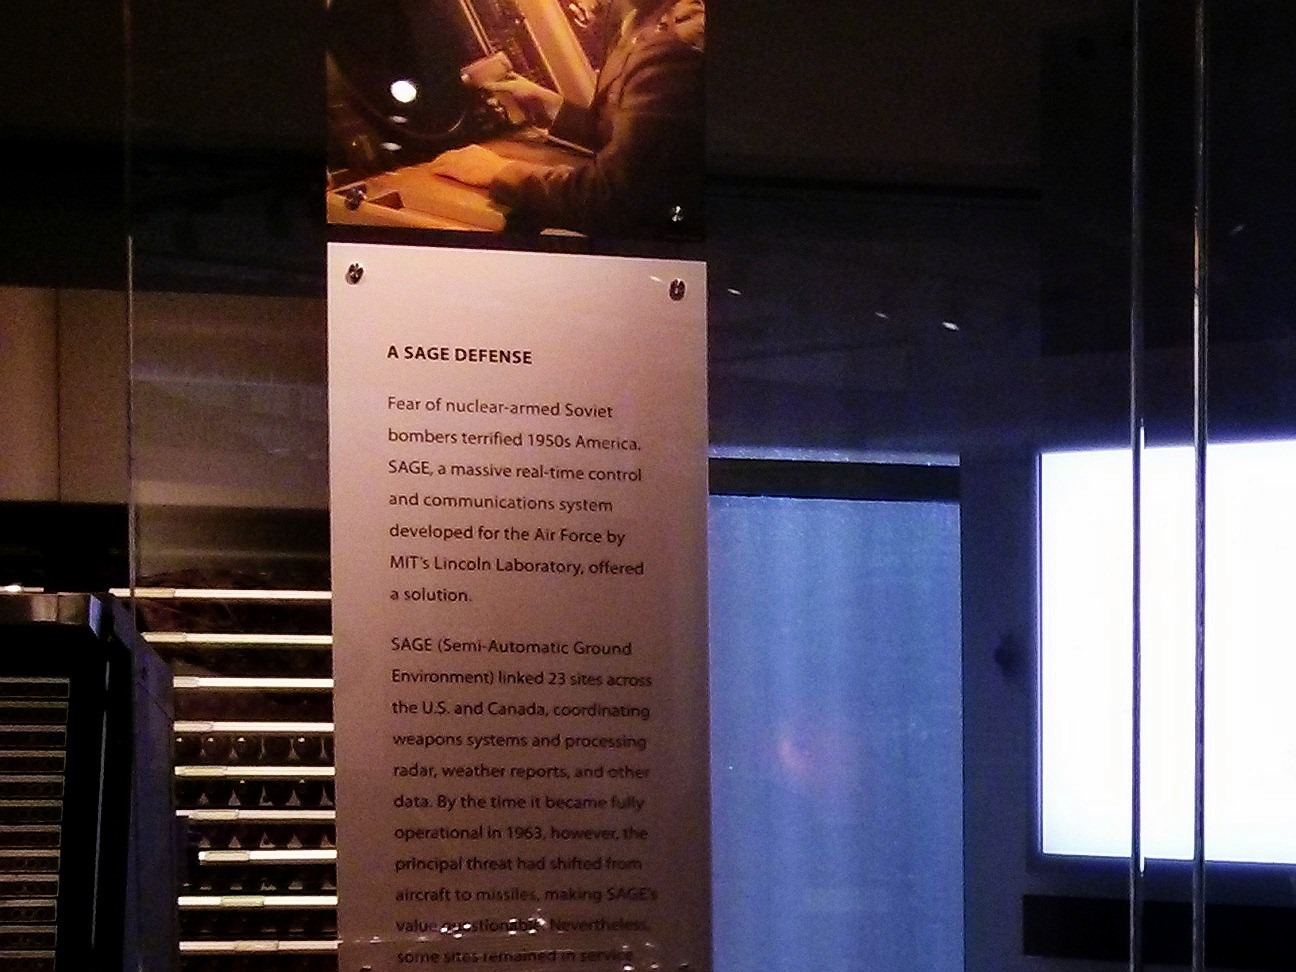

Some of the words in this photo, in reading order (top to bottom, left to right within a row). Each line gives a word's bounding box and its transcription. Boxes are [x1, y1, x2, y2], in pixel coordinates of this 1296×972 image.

[387, 345, 399, 359] A
[404, 345, 449, 361] SAGE
[455, 347, 531, 363] DEFENSE
[388, 398, 421, 412] Fear
[425, 399, 441, 412] of
[446, 399, 560, 415] nuclear-armed
[565, 402, 613, 417] Soviet
[388, 429, 457, 444] bombers
[461, 431, 522, 445] terrified
[528, 432, 571, 446] 1950s
[575, 433, 641, 448] America.
[389, 461, 433, 478] SAGE,
[438, 465, 446, 475] a
[451, 462, 512, 477] massive
[516, 464, 584, 478] real-time
[588, 466, 642, 480] control
[389, 492, 419, 506] and
[423, 493, 555, 509] communications
[560, 496, 613, 514] system
[389, 524, 473, 543] developed
[478, 526, 500, 539] for
[504, 526, 529, 540] the
[534, 527, 556, 540] Air
[560, 527, 602, 541] Force
[607, 528, 626, 546] by
[390, 556, 430, 570] MIT's
[434, 557, 491, 571] Lincoln
[496, 558, 584, 577] Laboratory,
[588, 560, 644, 574] offered
[390, 590, 399, 600] a
[404, 587, 472, 601] solution.
[391, 637, 432, 651] SAGE
[438, 638, 568, 657] (Semi-Automatic
[573, 640, 632, 654] Ground
[392, 669, 494, 686] Environment)
[498, 671, 544, 685] linked
[548, 672, 566, 685] 23
[570, 673, 603, 686] sites
[606, 676, 652, 687] across
[392, 701, 418, 714] the
[422, 702, 450, 715] U.S.
[454, 702, 484, 716] and
[487, 703, 549, 718] Canada,
[552, 704, 650, 721] coordinating
[392, 735, 463, 750] weapons
[467, 733, 528, 749] systems
[532, 734, 561, 748] and
[564, 735, 647, 751] processing
[393, 763, 437, 778] radar,
[441, 764, 505, 778] weather
[510, 765, 570, 781] reports,
[574, 766, 604, 779] and
[607, 766, 650, 780] other
[437, 796, 456, 811] By
[460, 796, 487, 809] the
[490, 796, 527, 810] time
[531, 797, 541, 810] it
[545, 797, 607, 811] became
[610, 798, 645, 814] fully
[394, 826, 483, 842] operational
[487, 827, 502, 840] in
[622, 829, 648, 842] the
[394, 857, 463, 873] principal
[466, 858, 513, 871] threat
[516, 858, 546, 872] had
[550, 859, 602, 872] shifted
[605, 859, 642, 873] from
